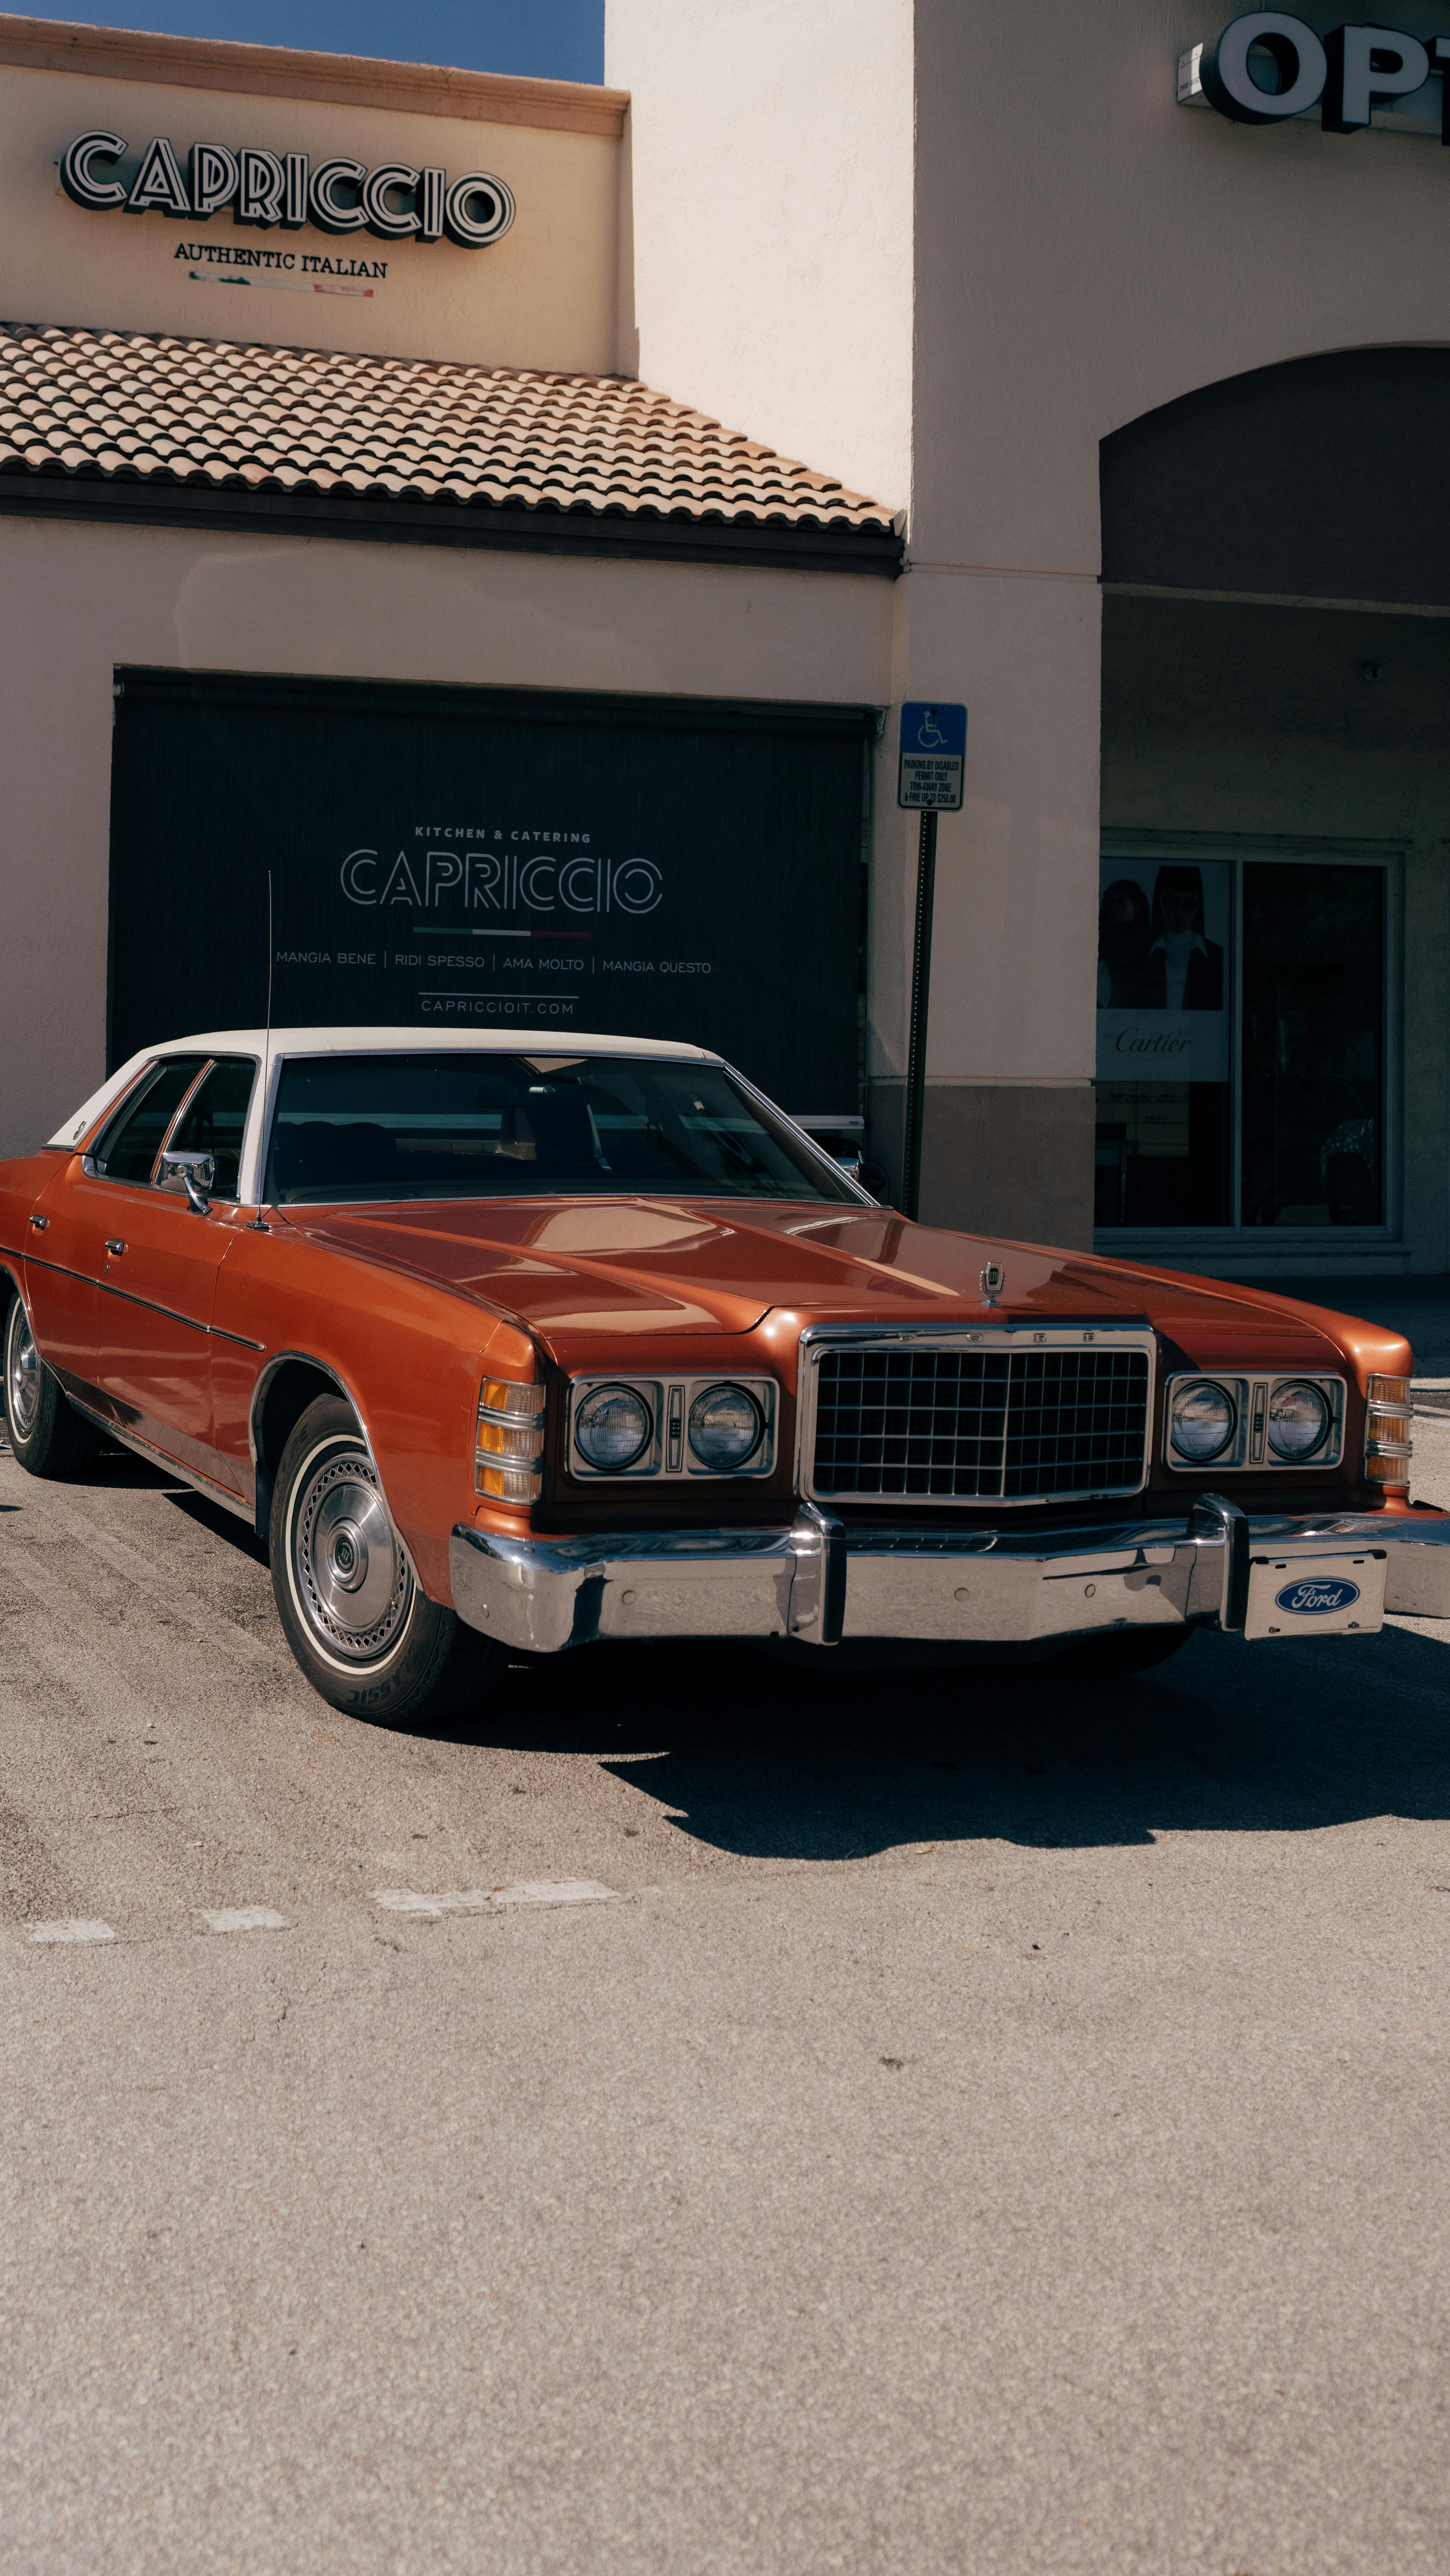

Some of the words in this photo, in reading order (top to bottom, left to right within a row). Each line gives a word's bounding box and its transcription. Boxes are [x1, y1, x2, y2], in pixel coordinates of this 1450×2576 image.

[1218, 11, 1450, 126] OP
[62, 129, 516, 247] CAPRICCIO
[174, 243, 295, 269] AUTHENTIC
[301, 255, 388, 278] ITALIAN
[904, 759, 926, 770] PARKING
[927, 761, 934, 770] BY
[935, 761, 959, 771] DISABLED
[915, 771, 934, 781] PERMIT
[935, 772, 948, 781] ONLY
[904, 793, 908, 802] &
[910, 792, 921, 802] FINE
[922, 793, 929, 803] UP
[930, 793, 936, 803] TO
[910, 781, 938, 791] TOW-AWAY
[938, 783, 951, 793] ZONE
[415, 826, 485, 838] KITCHEN
[494, 830, 502, 840] &
[511, 831, 590, 843] CATERING
[340, 849, 663, 914] CAPRICCIO
[277, 951, 332, 963] MANGIA
[338, 953, 376, 965] BENE
[395, 954, 421, 966] RIDI
[427, 955, 485, 967] SPESSO
[503, 958, 533, 969] AMA
[539, 959, 584, 970] MOLTO
[603, 960, 655, 972] MANGIA
[660, 962, 711, 973] QUESTO
[421, 1000, 573, 1014] CAPRICCIOIT.COM
[1115, 1028, 1192, 1053] Cartier
[1291, 1584, 1343, 1609] Ford
[346, 1639, 418, 1704] CLASSIC
